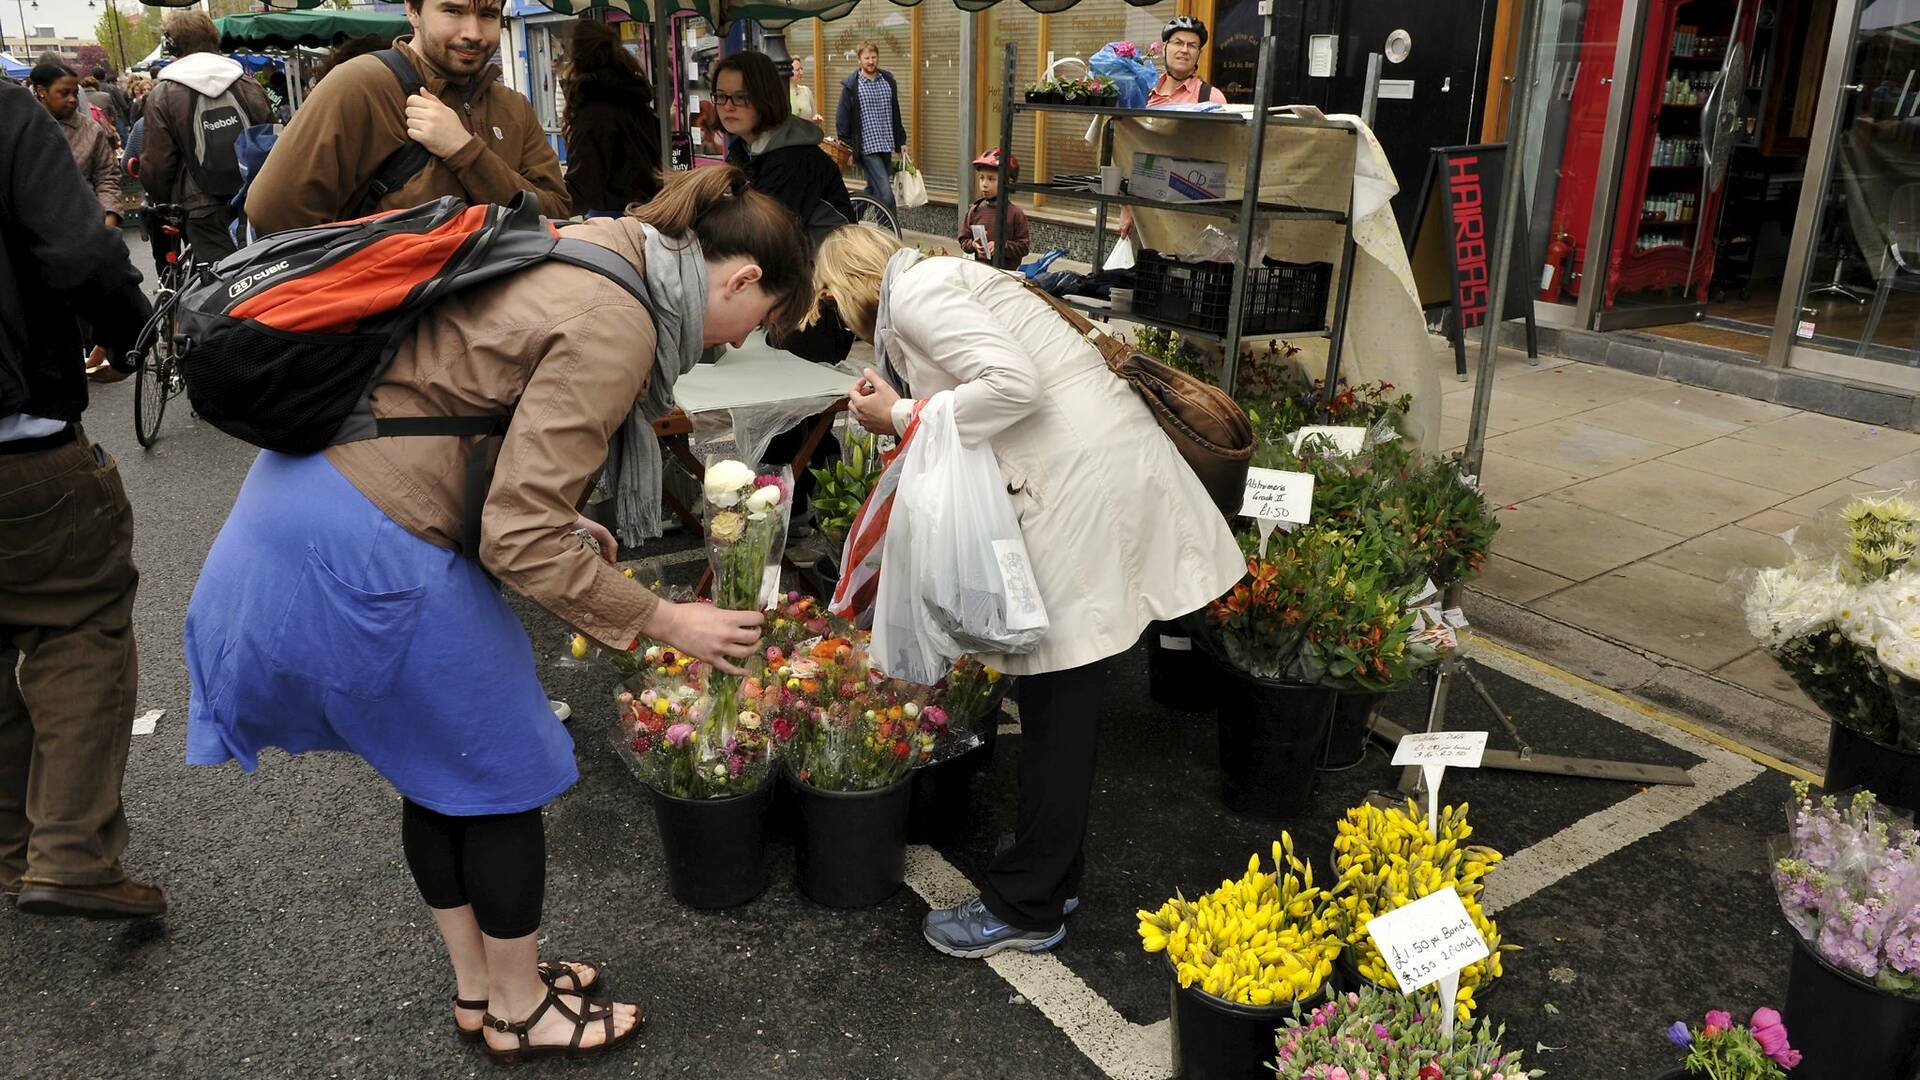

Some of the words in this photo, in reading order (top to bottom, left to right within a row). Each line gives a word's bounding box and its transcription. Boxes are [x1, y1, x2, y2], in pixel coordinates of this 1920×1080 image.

[202, 115, 238, 130] Reebok
[672, 163, 688, 172] auty
[1448, 155, 1489, 330] HAIRBASE
[252, 260, 290, 280] CUBIC
[1259, 502, 1290, 518] £1.50
